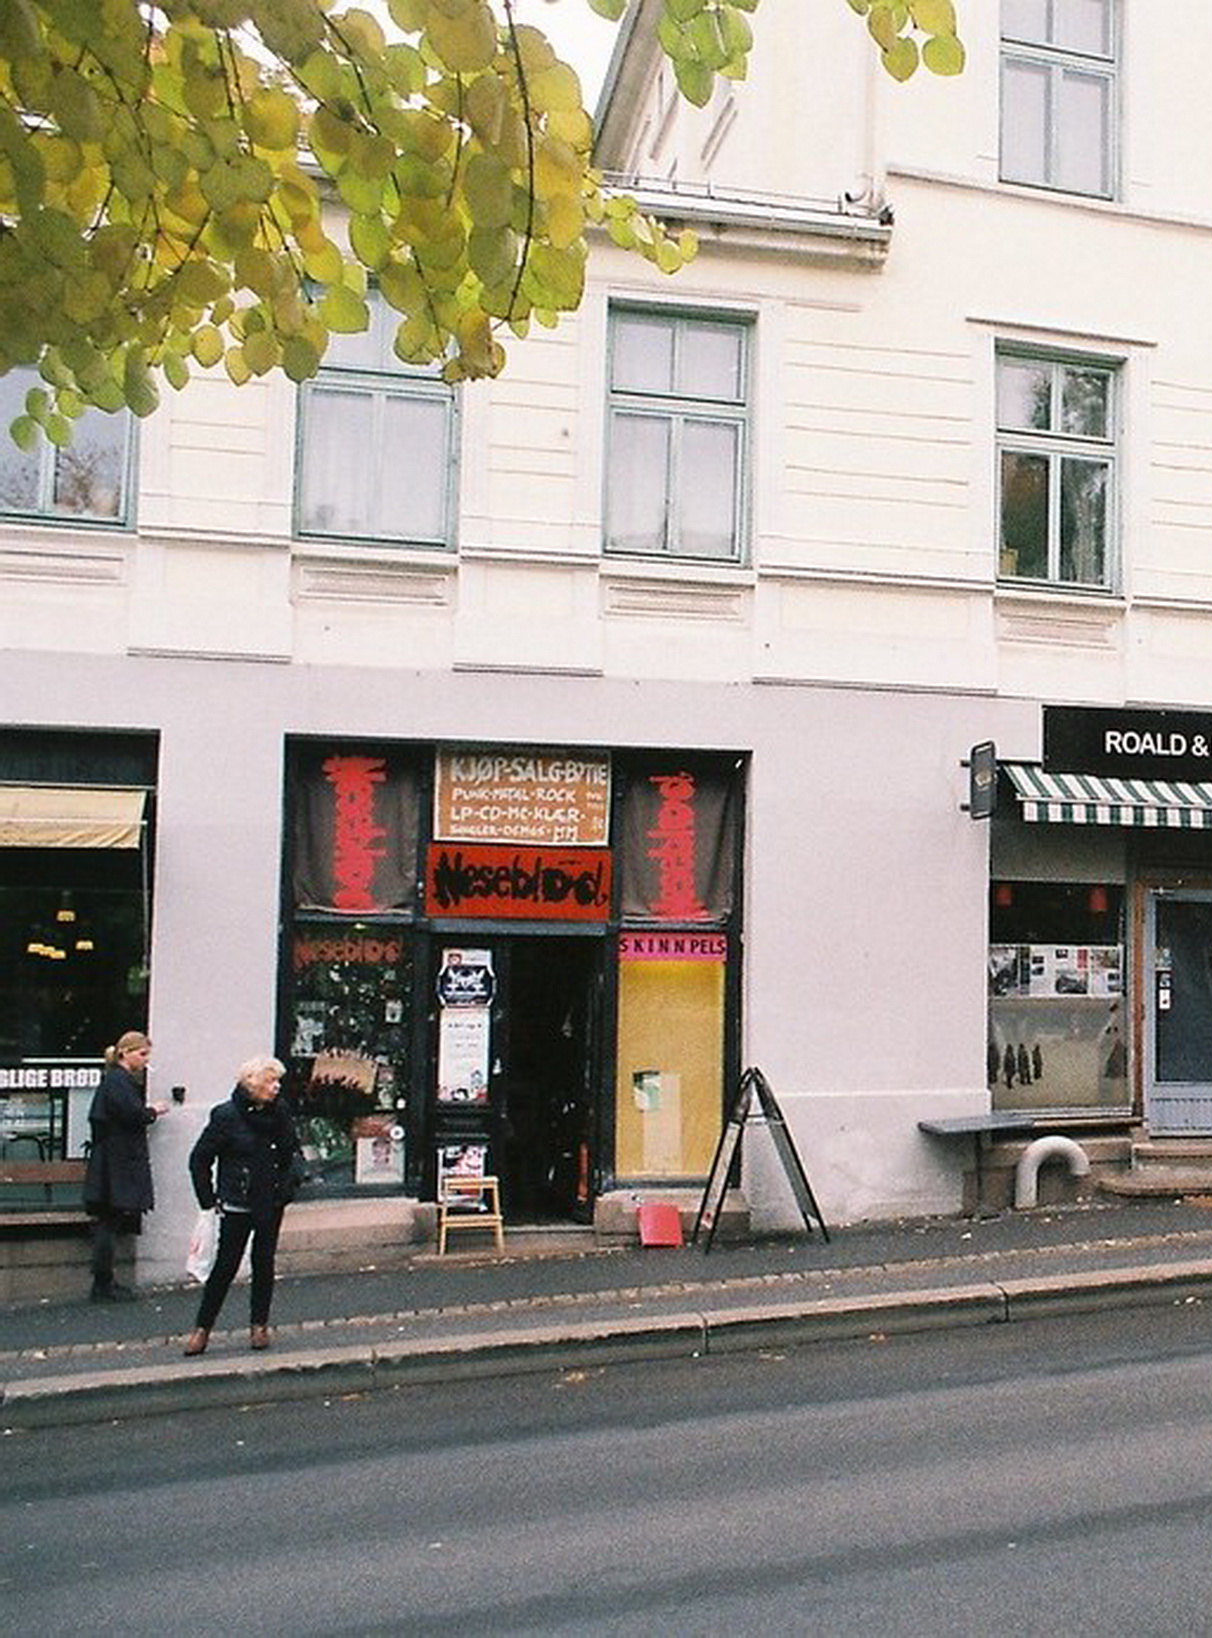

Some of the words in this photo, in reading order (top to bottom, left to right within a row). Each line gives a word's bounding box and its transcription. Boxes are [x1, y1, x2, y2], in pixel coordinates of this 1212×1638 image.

[1105, 731, 1187, 756] ROALD
[1192, 735, 1209, 757] &
[619, 938, 685, 955] SKINN
[690, 938, 726, 955] PELS
[50, 1068, 101, 1088] BRØD
